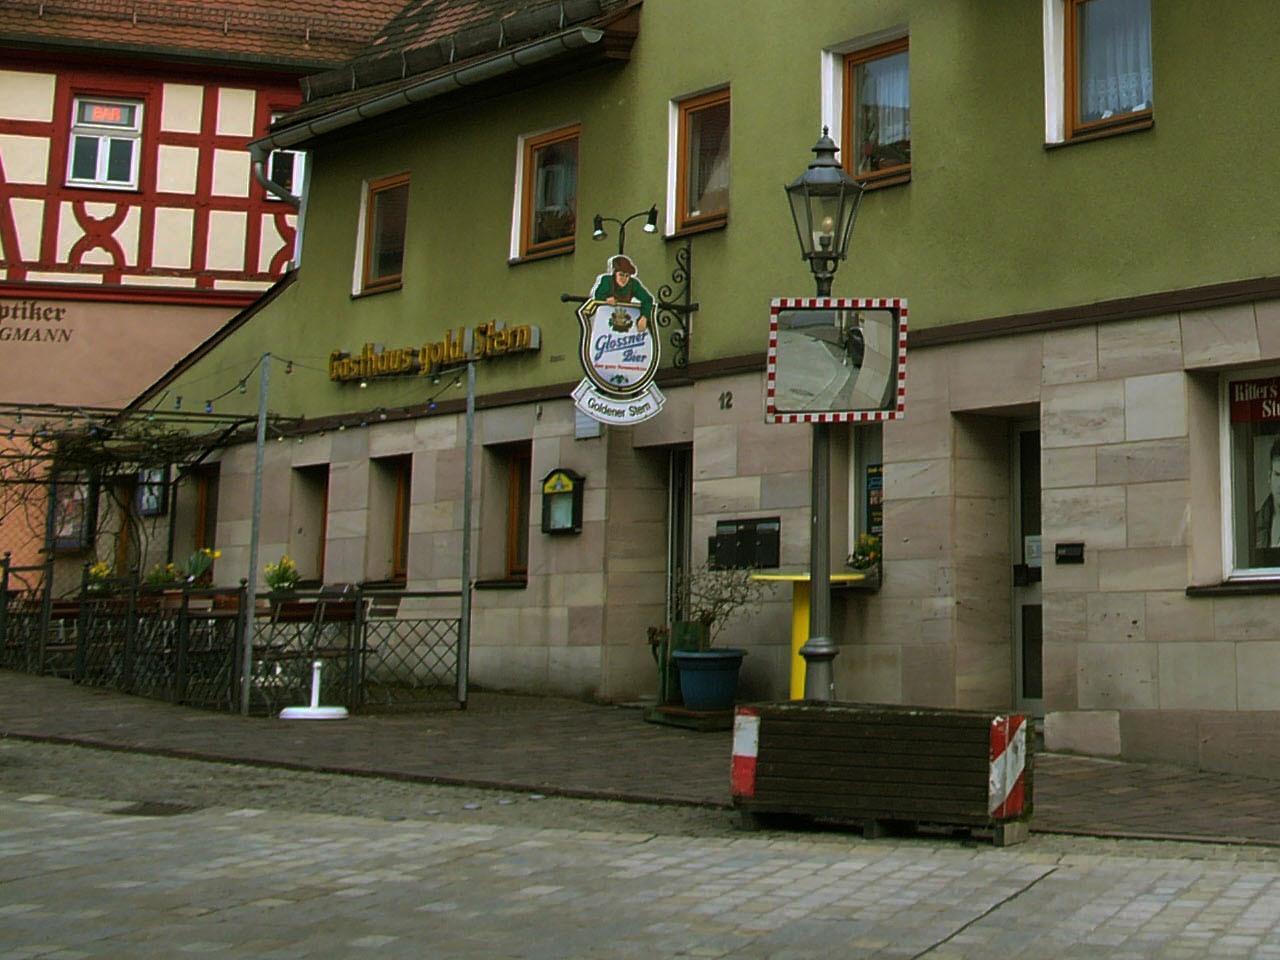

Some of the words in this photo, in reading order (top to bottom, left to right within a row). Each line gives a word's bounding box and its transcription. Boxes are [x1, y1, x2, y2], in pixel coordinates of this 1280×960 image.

[0, 326, 74, 343] GMANN
[329, 342, 413, 381] Gasthaus
[474, 319, 531, 358] Stern
[594, 332, 649, 362] Glossner
[623, 349, 648, 363] Bier
[587, 398, 626, 418] Goldener
[628, 402, 651, 417] Stern
[718, 391, 733, 410] 12
